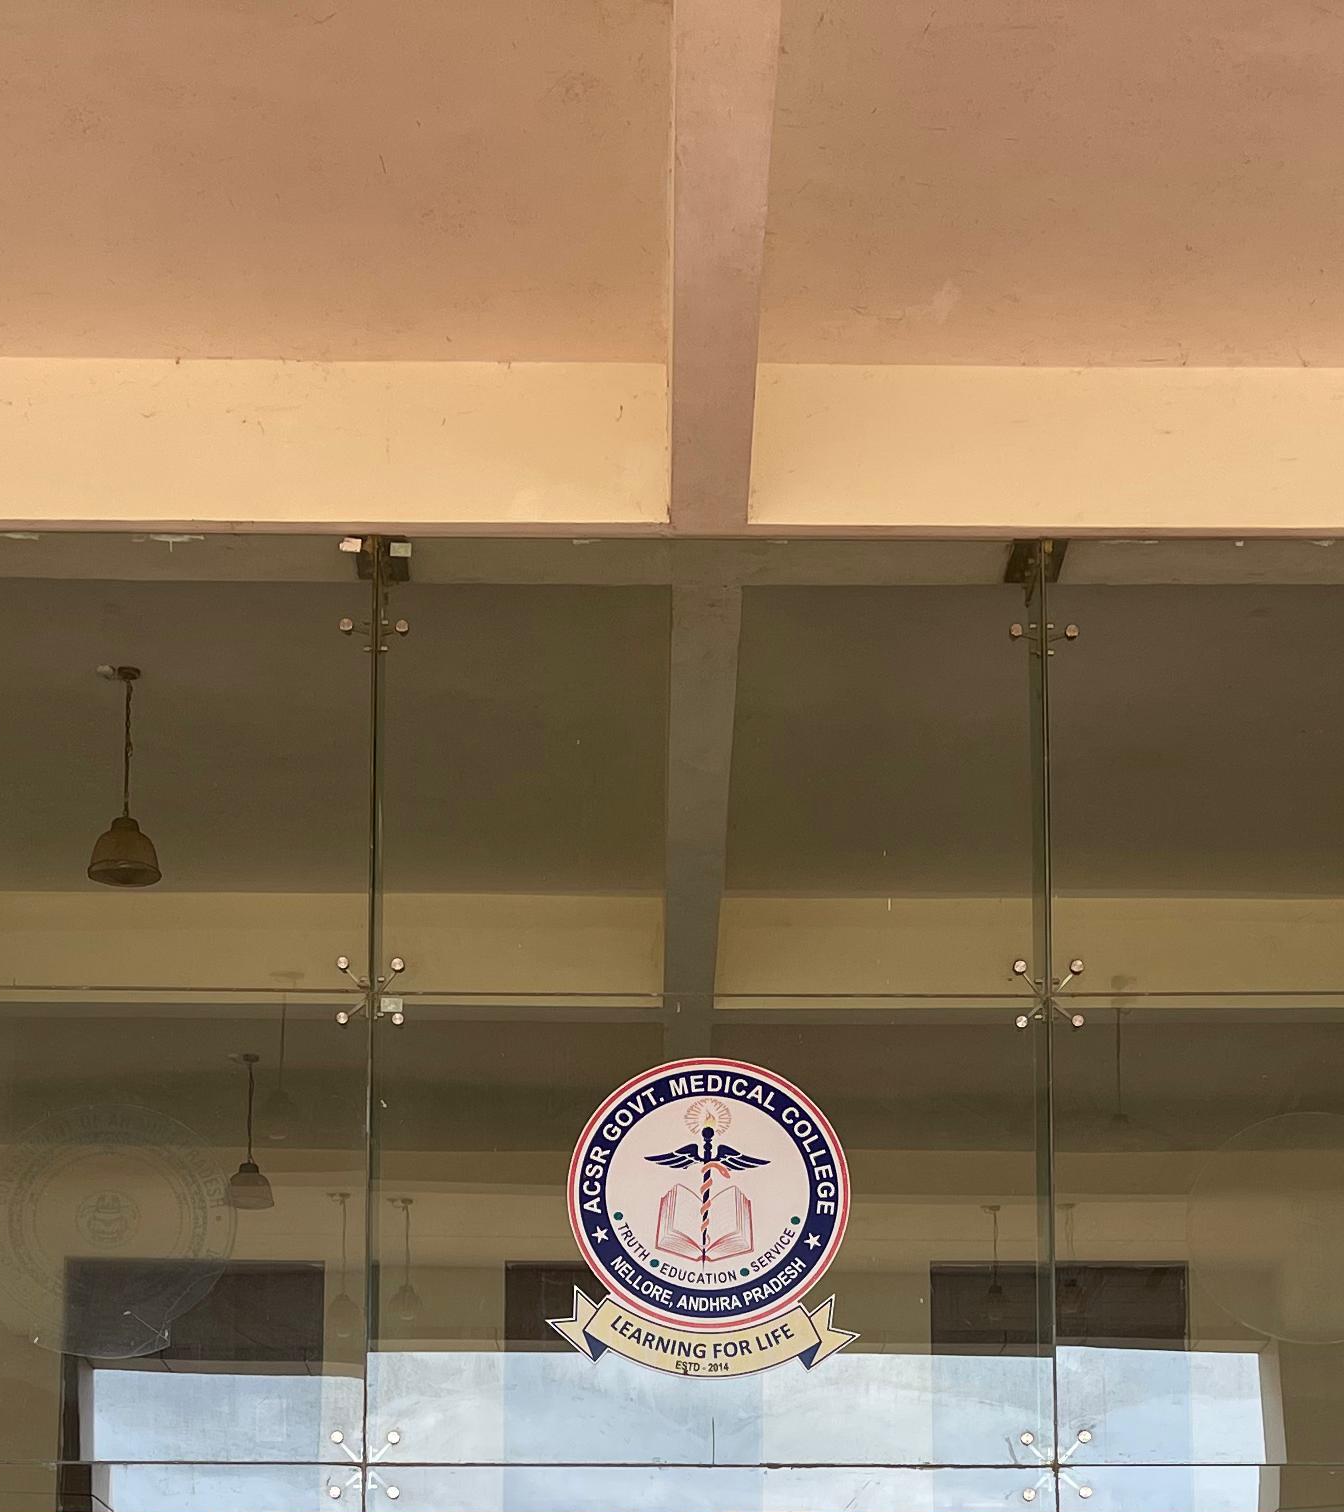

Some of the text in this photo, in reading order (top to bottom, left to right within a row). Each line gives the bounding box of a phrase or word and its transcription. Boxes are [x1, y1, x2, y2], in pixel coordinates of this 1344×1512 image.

[583, 1074, 835, 1215] ACSR GOVT. MEDICAL COLLEGE
[618, 1222, 796, 1284] TRUTH EDUCATION SERVICE
[610, 1255, 807, 1312] NELLORE, ANDHRA PRADESH
[610, 1315, 795, 1359] LEARNING FOR LIFE
[675, 1360, 700, 1372] ESTD
[708, 1362, 730, 1372] 2014
